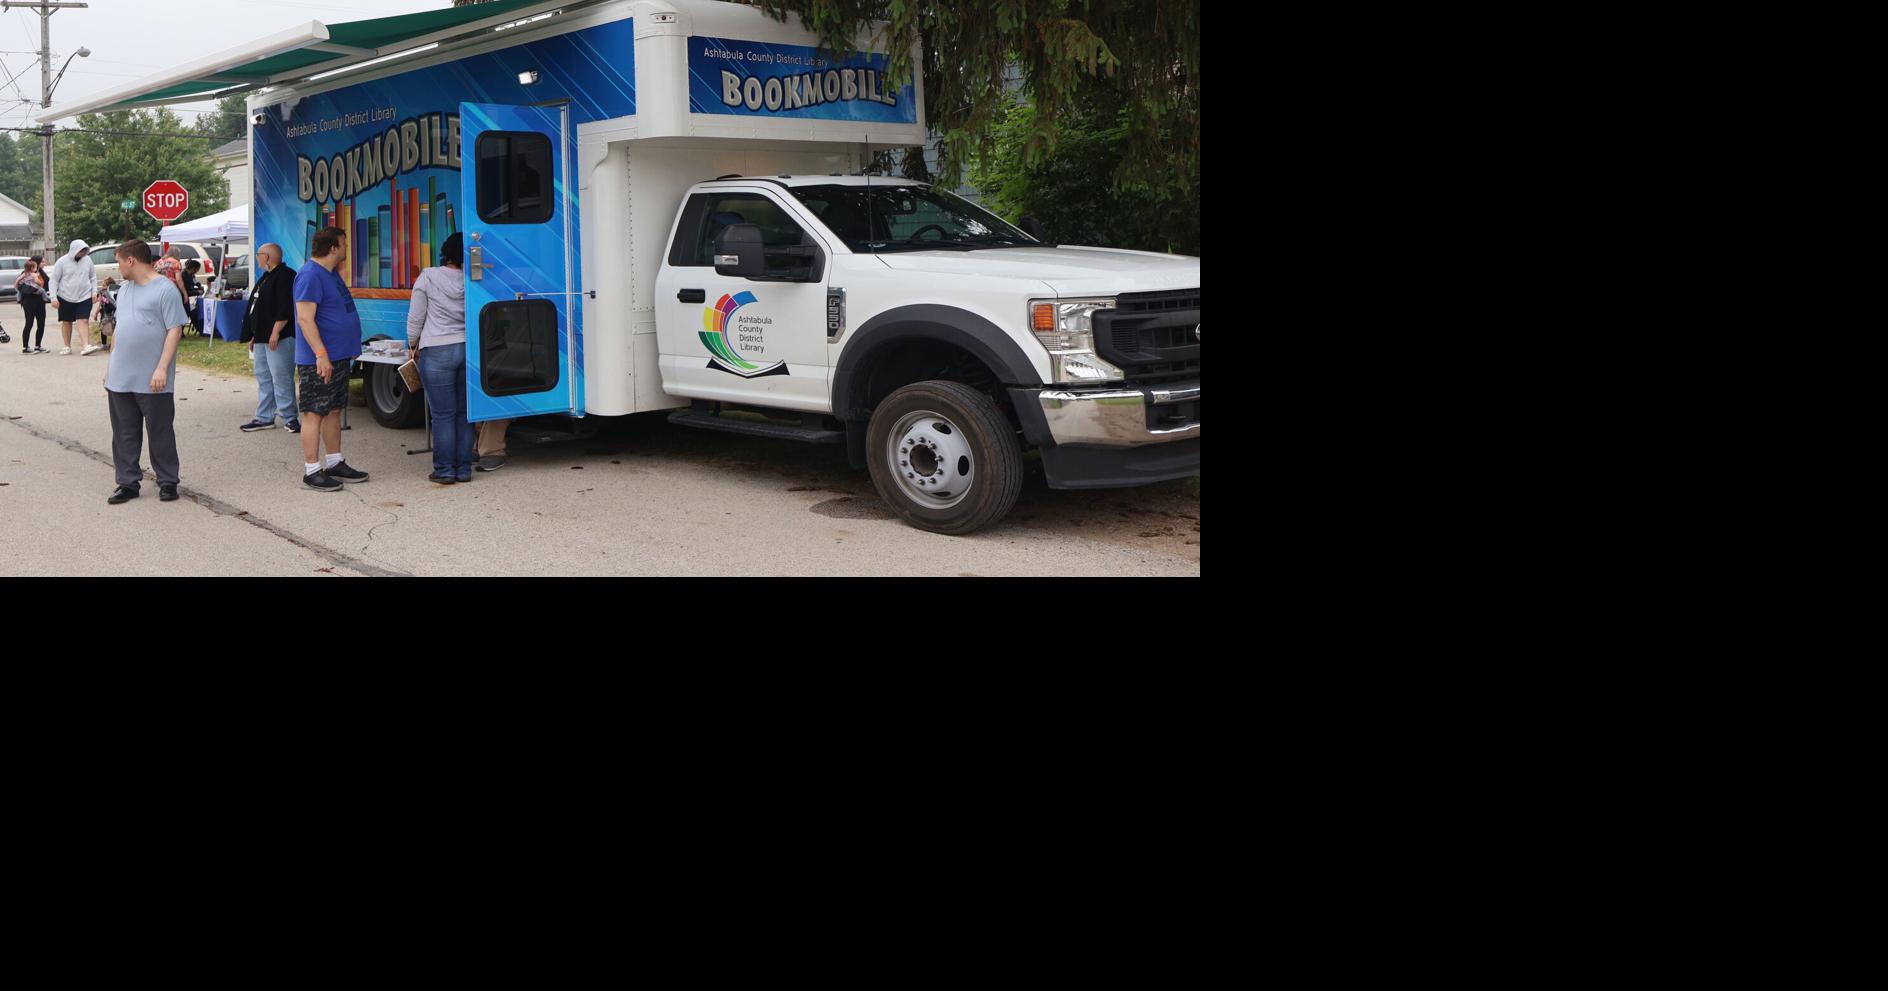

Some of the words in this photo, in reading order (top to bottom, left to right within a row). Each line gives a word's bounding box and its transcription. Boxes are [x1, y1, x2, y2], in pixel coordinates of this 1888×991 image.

[704, 47, 743, 60] Ashtabula
[748, 51, 773, 64] County
[777, 54, 801, 65] District
[804, 57, 828, 69] Libary
[286, 123, 318, 138] Ashtabula
[319, 118, 343, 132] County
[344, 112, 369, 126] District
[371, 106, 397, 122] Library
[147, 193, 185, 208] STOP
[738, 316, 772, 325] Ashtabula
[738, 324, 763, 334] County
[739, 334, 763, 343] District
[740, 344, 764, 354] Library
